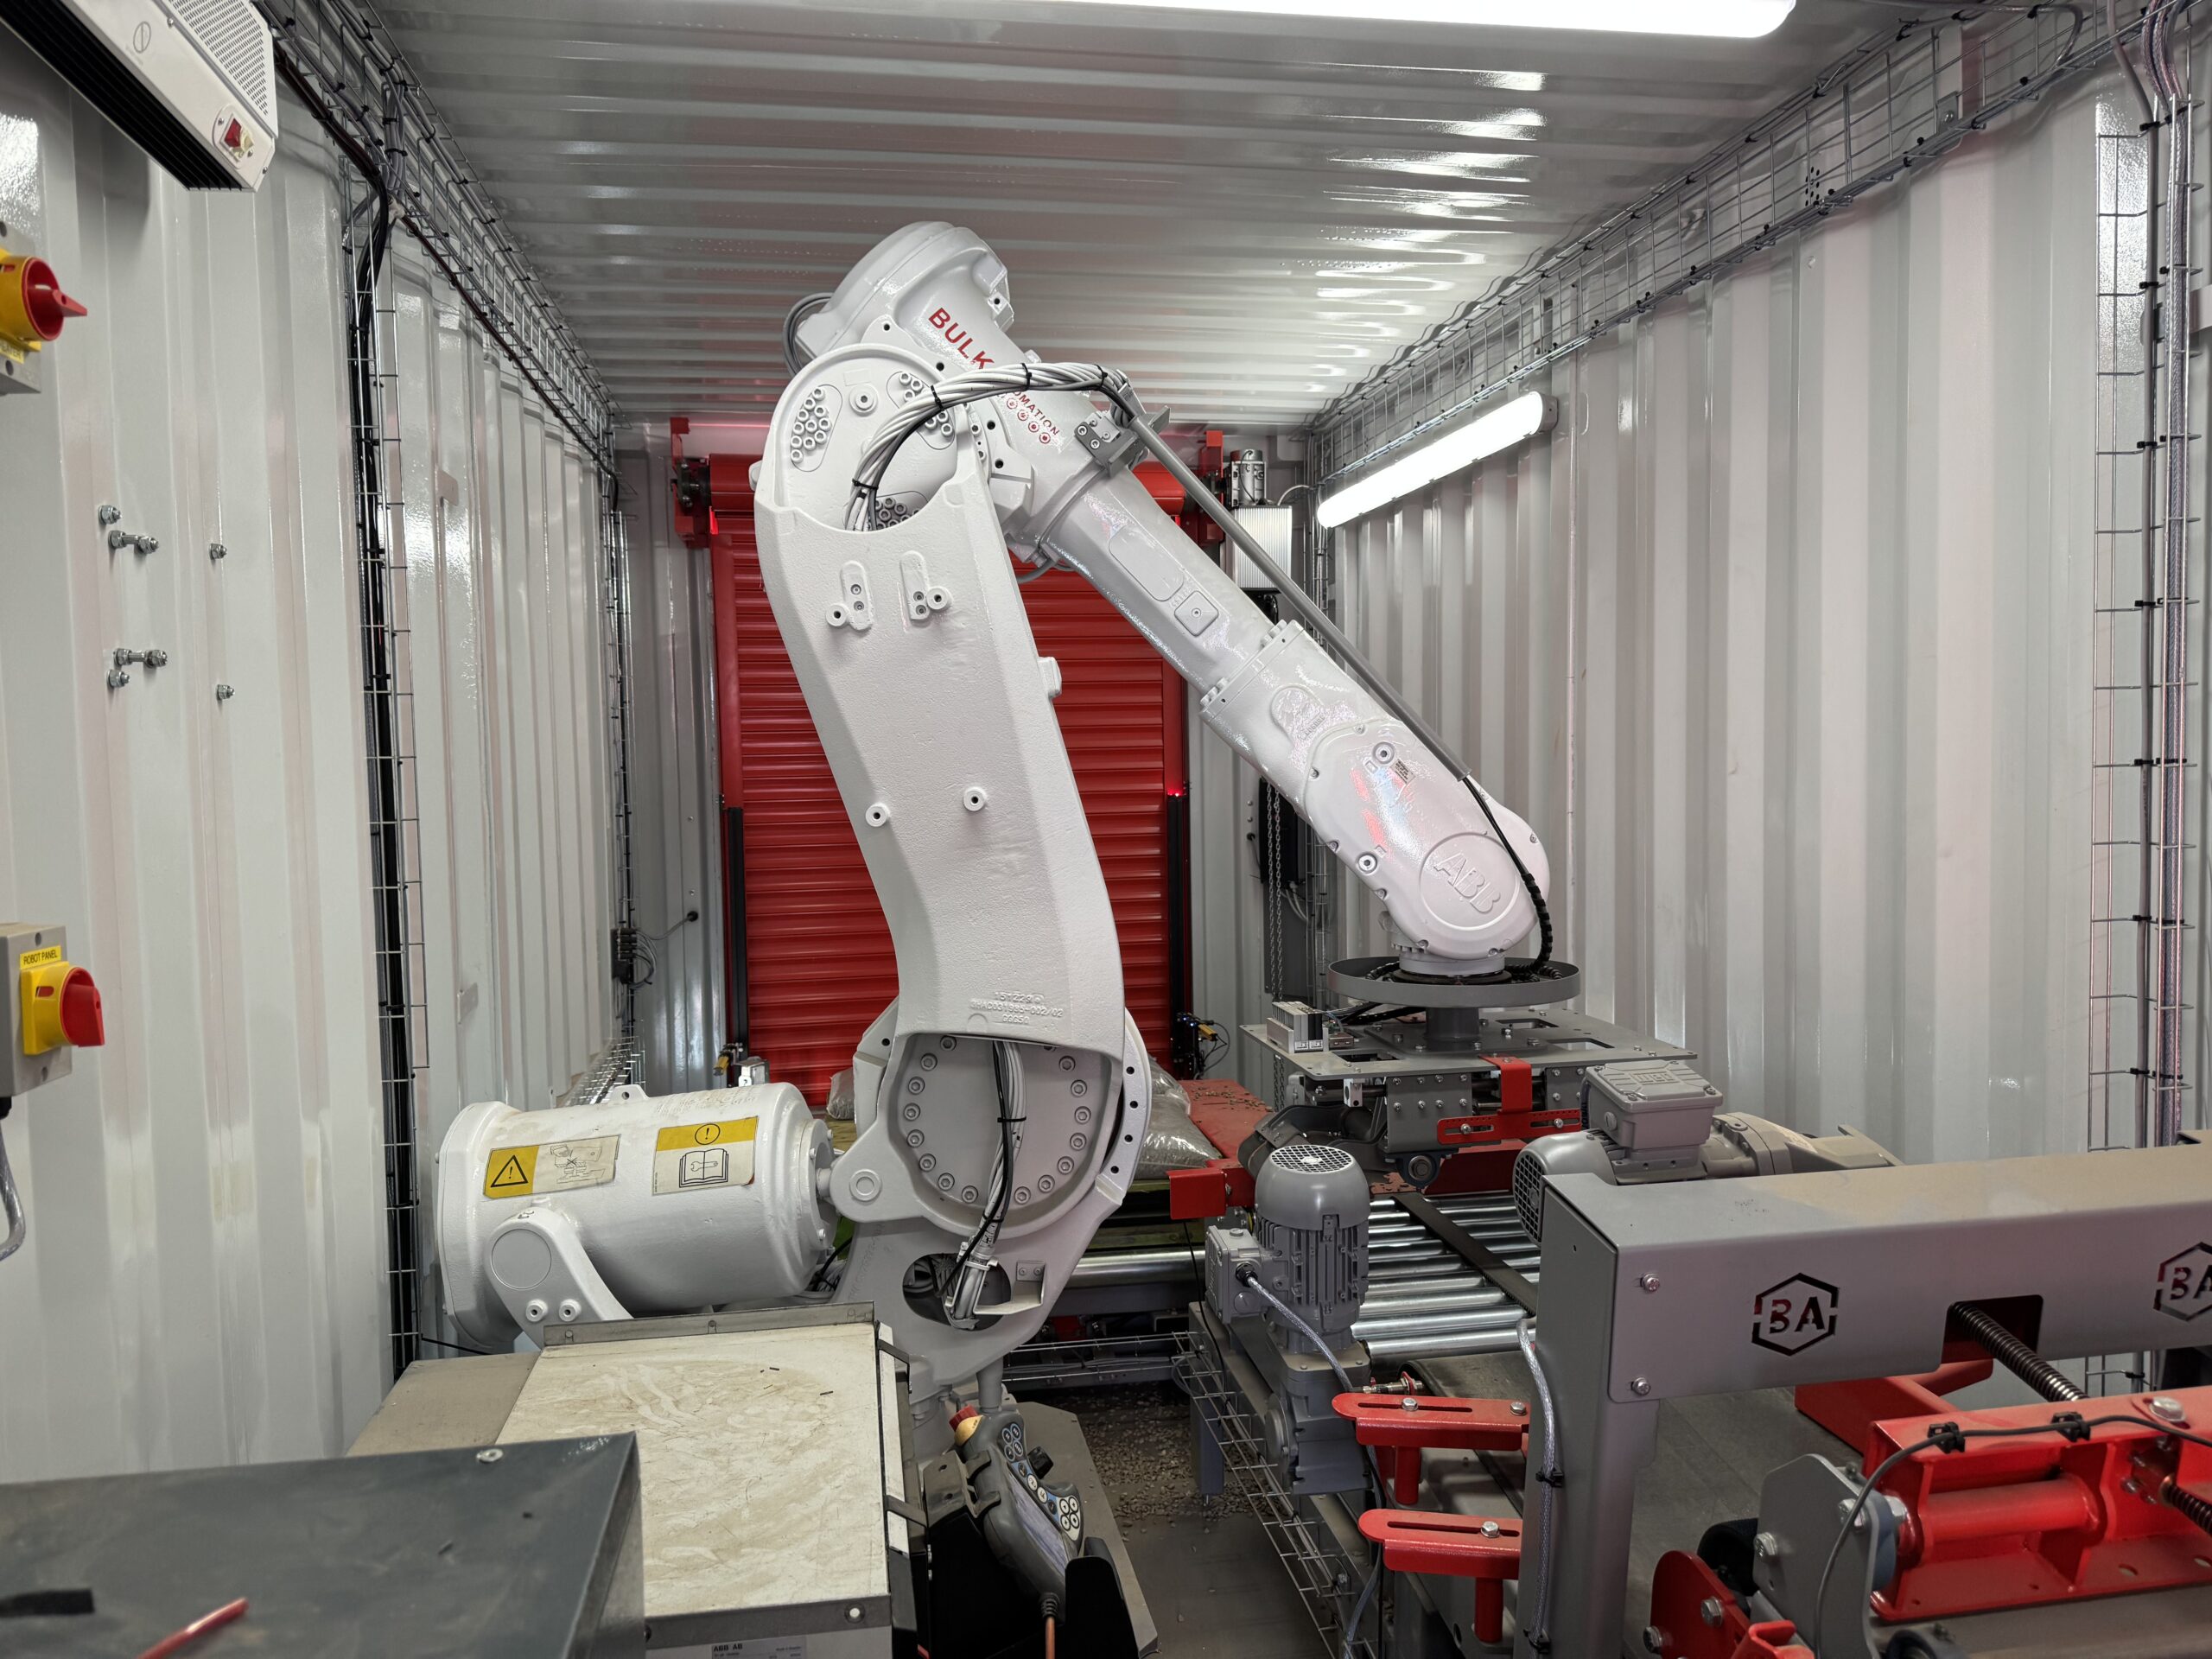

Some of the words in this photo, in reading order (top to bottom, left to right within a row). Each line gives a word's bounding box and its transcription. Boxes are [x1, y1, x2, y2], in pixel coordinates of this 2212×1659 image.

[928, 307, 995, 370] BULK
[1433, 852, 1501, 915] ABB
[23, 952, 41, 965] ROBOT
[41, 949, 57, 961] PANEL
[1769, 1296, 1826, 1334] BA
